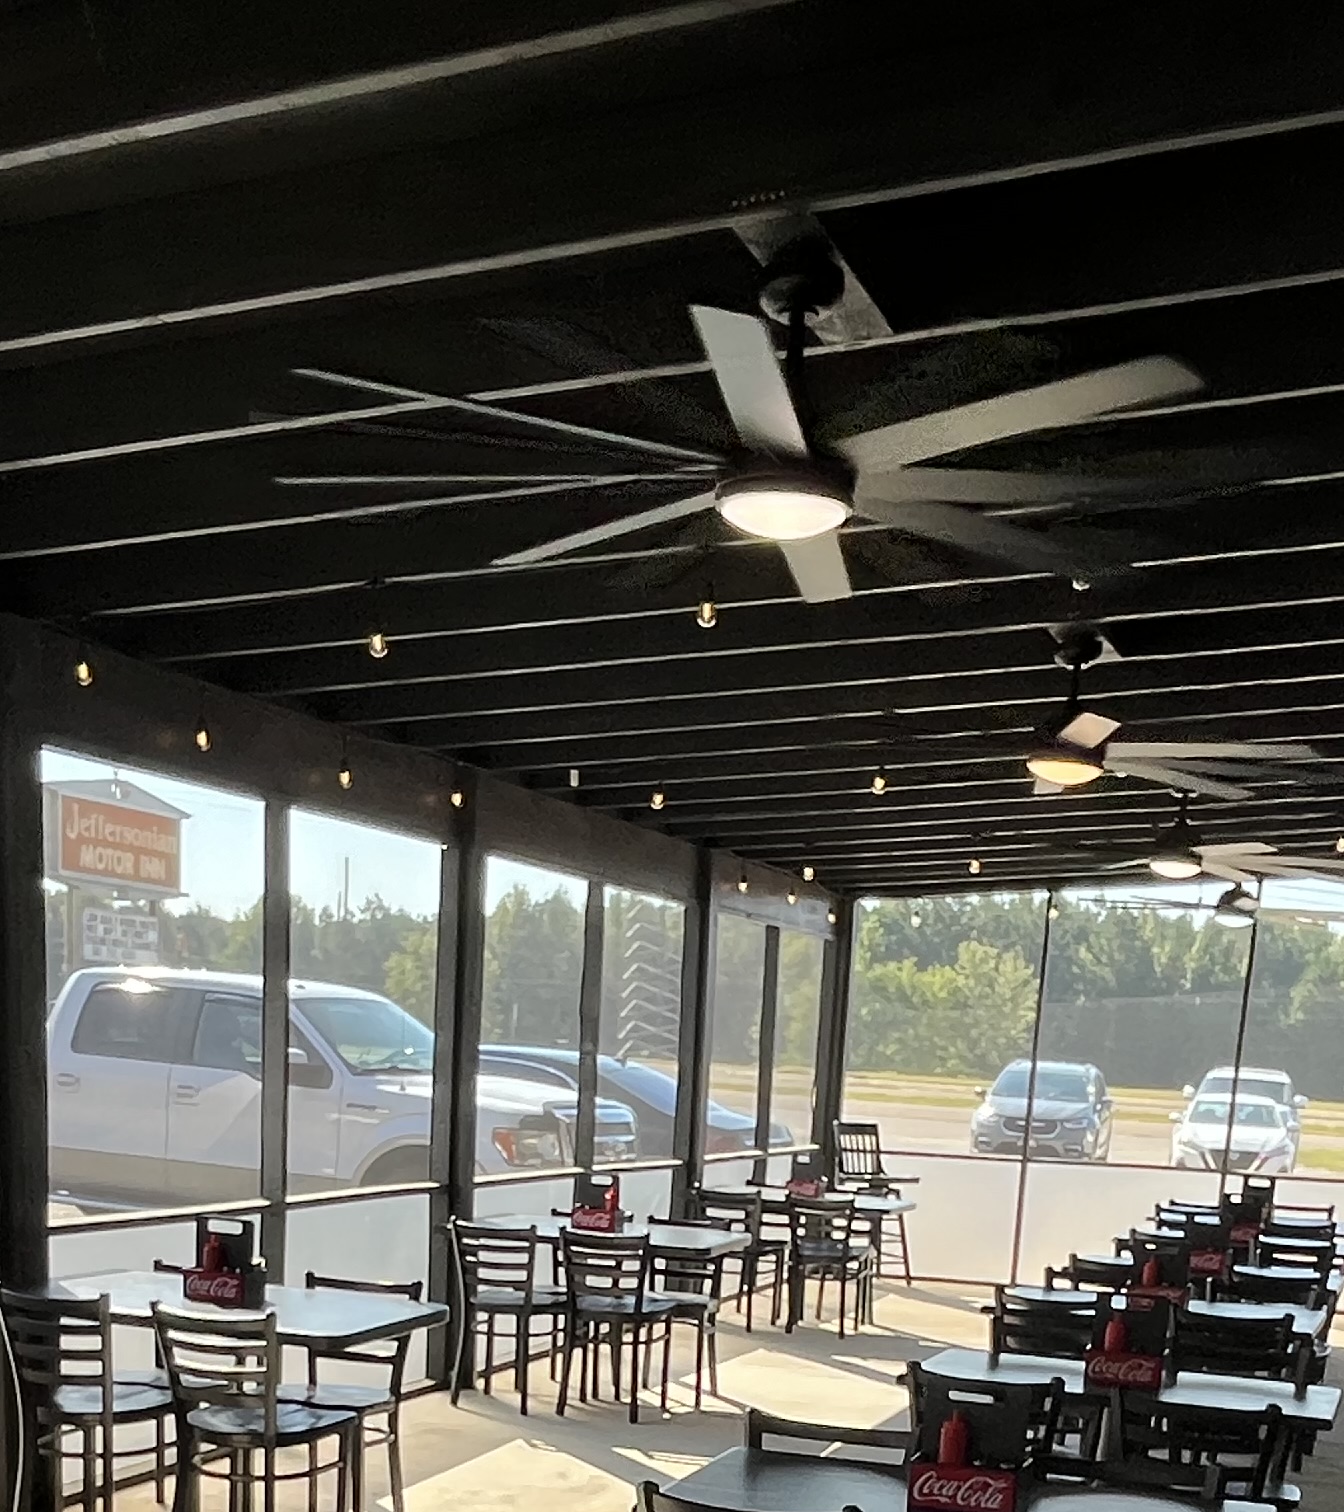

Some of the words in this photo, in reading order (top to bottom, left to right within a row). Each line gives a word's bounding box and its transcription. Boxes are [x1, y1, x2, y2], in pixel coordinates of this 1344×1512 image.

[65, 803, 176, 855] Jeffersonian
[79, 844, 134, 876] MOTOR
[139, 854, 166, 880] INN
